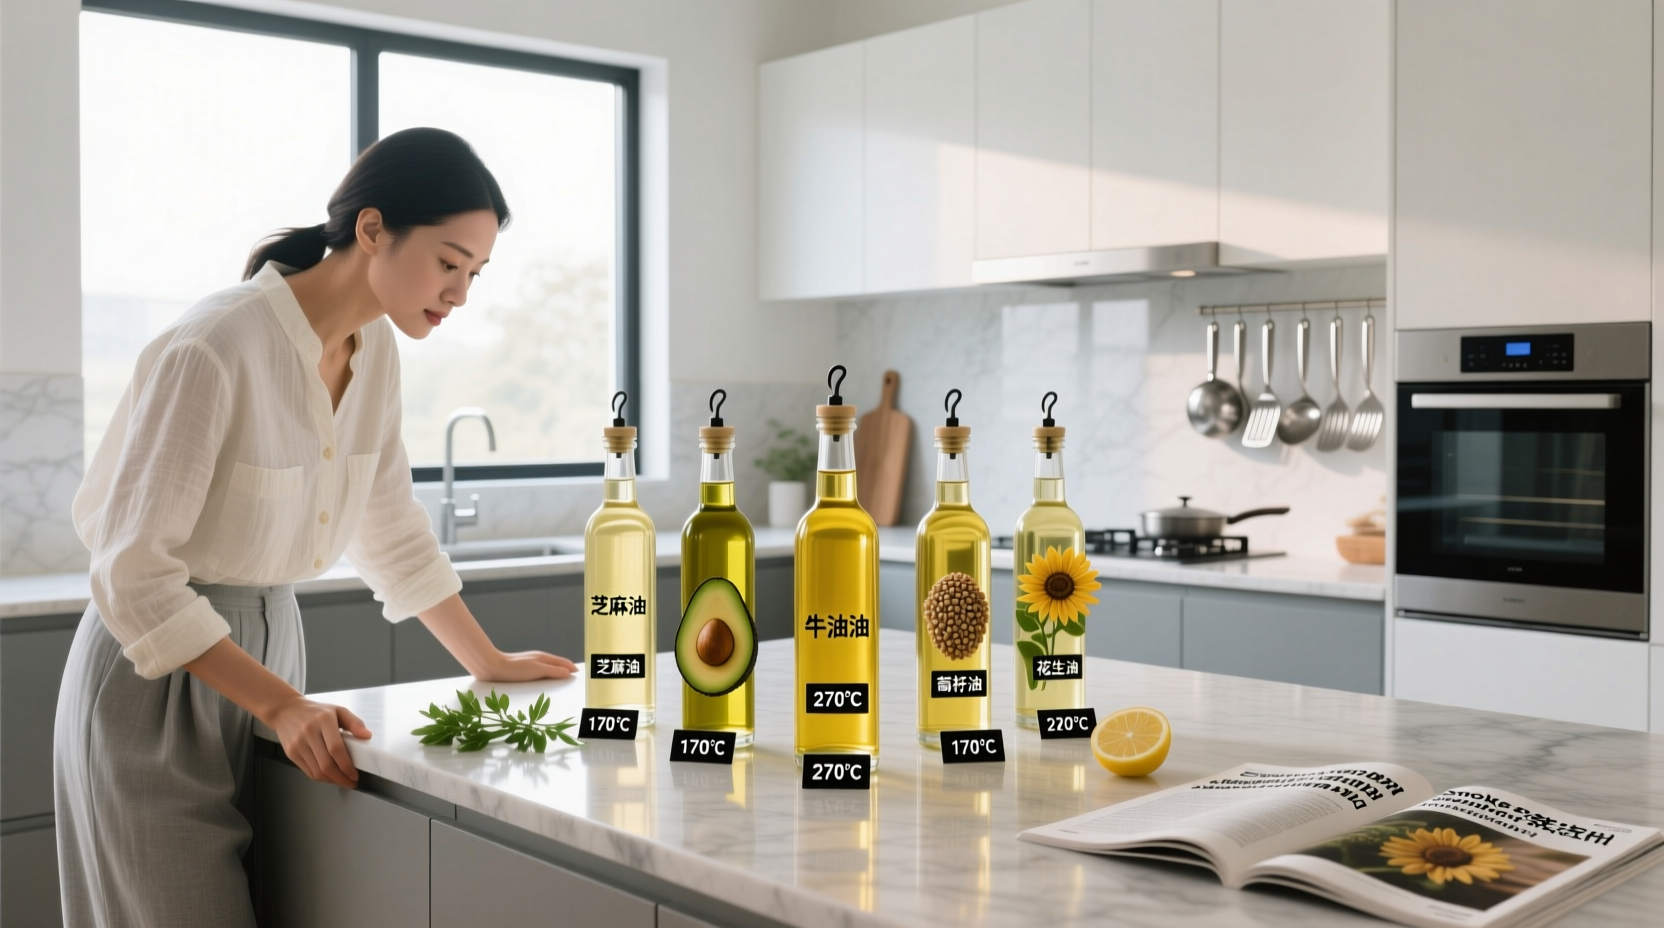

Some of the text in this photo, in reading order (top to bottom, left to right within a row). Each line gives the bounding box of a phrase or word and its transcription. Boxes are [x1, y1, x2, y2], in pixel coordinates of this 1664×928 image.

[591, 595, 646, 616] 芝麻油
[805, 614, 870, 640] 牛油油
[813, 690, 862, 708] 270°C
[588, 716, 631, 732] 170°C
[680, 739, 726, 756] 170°C
[951, 738, 997, 755] 170°C
[812, 763, 862, 781] 270°C
